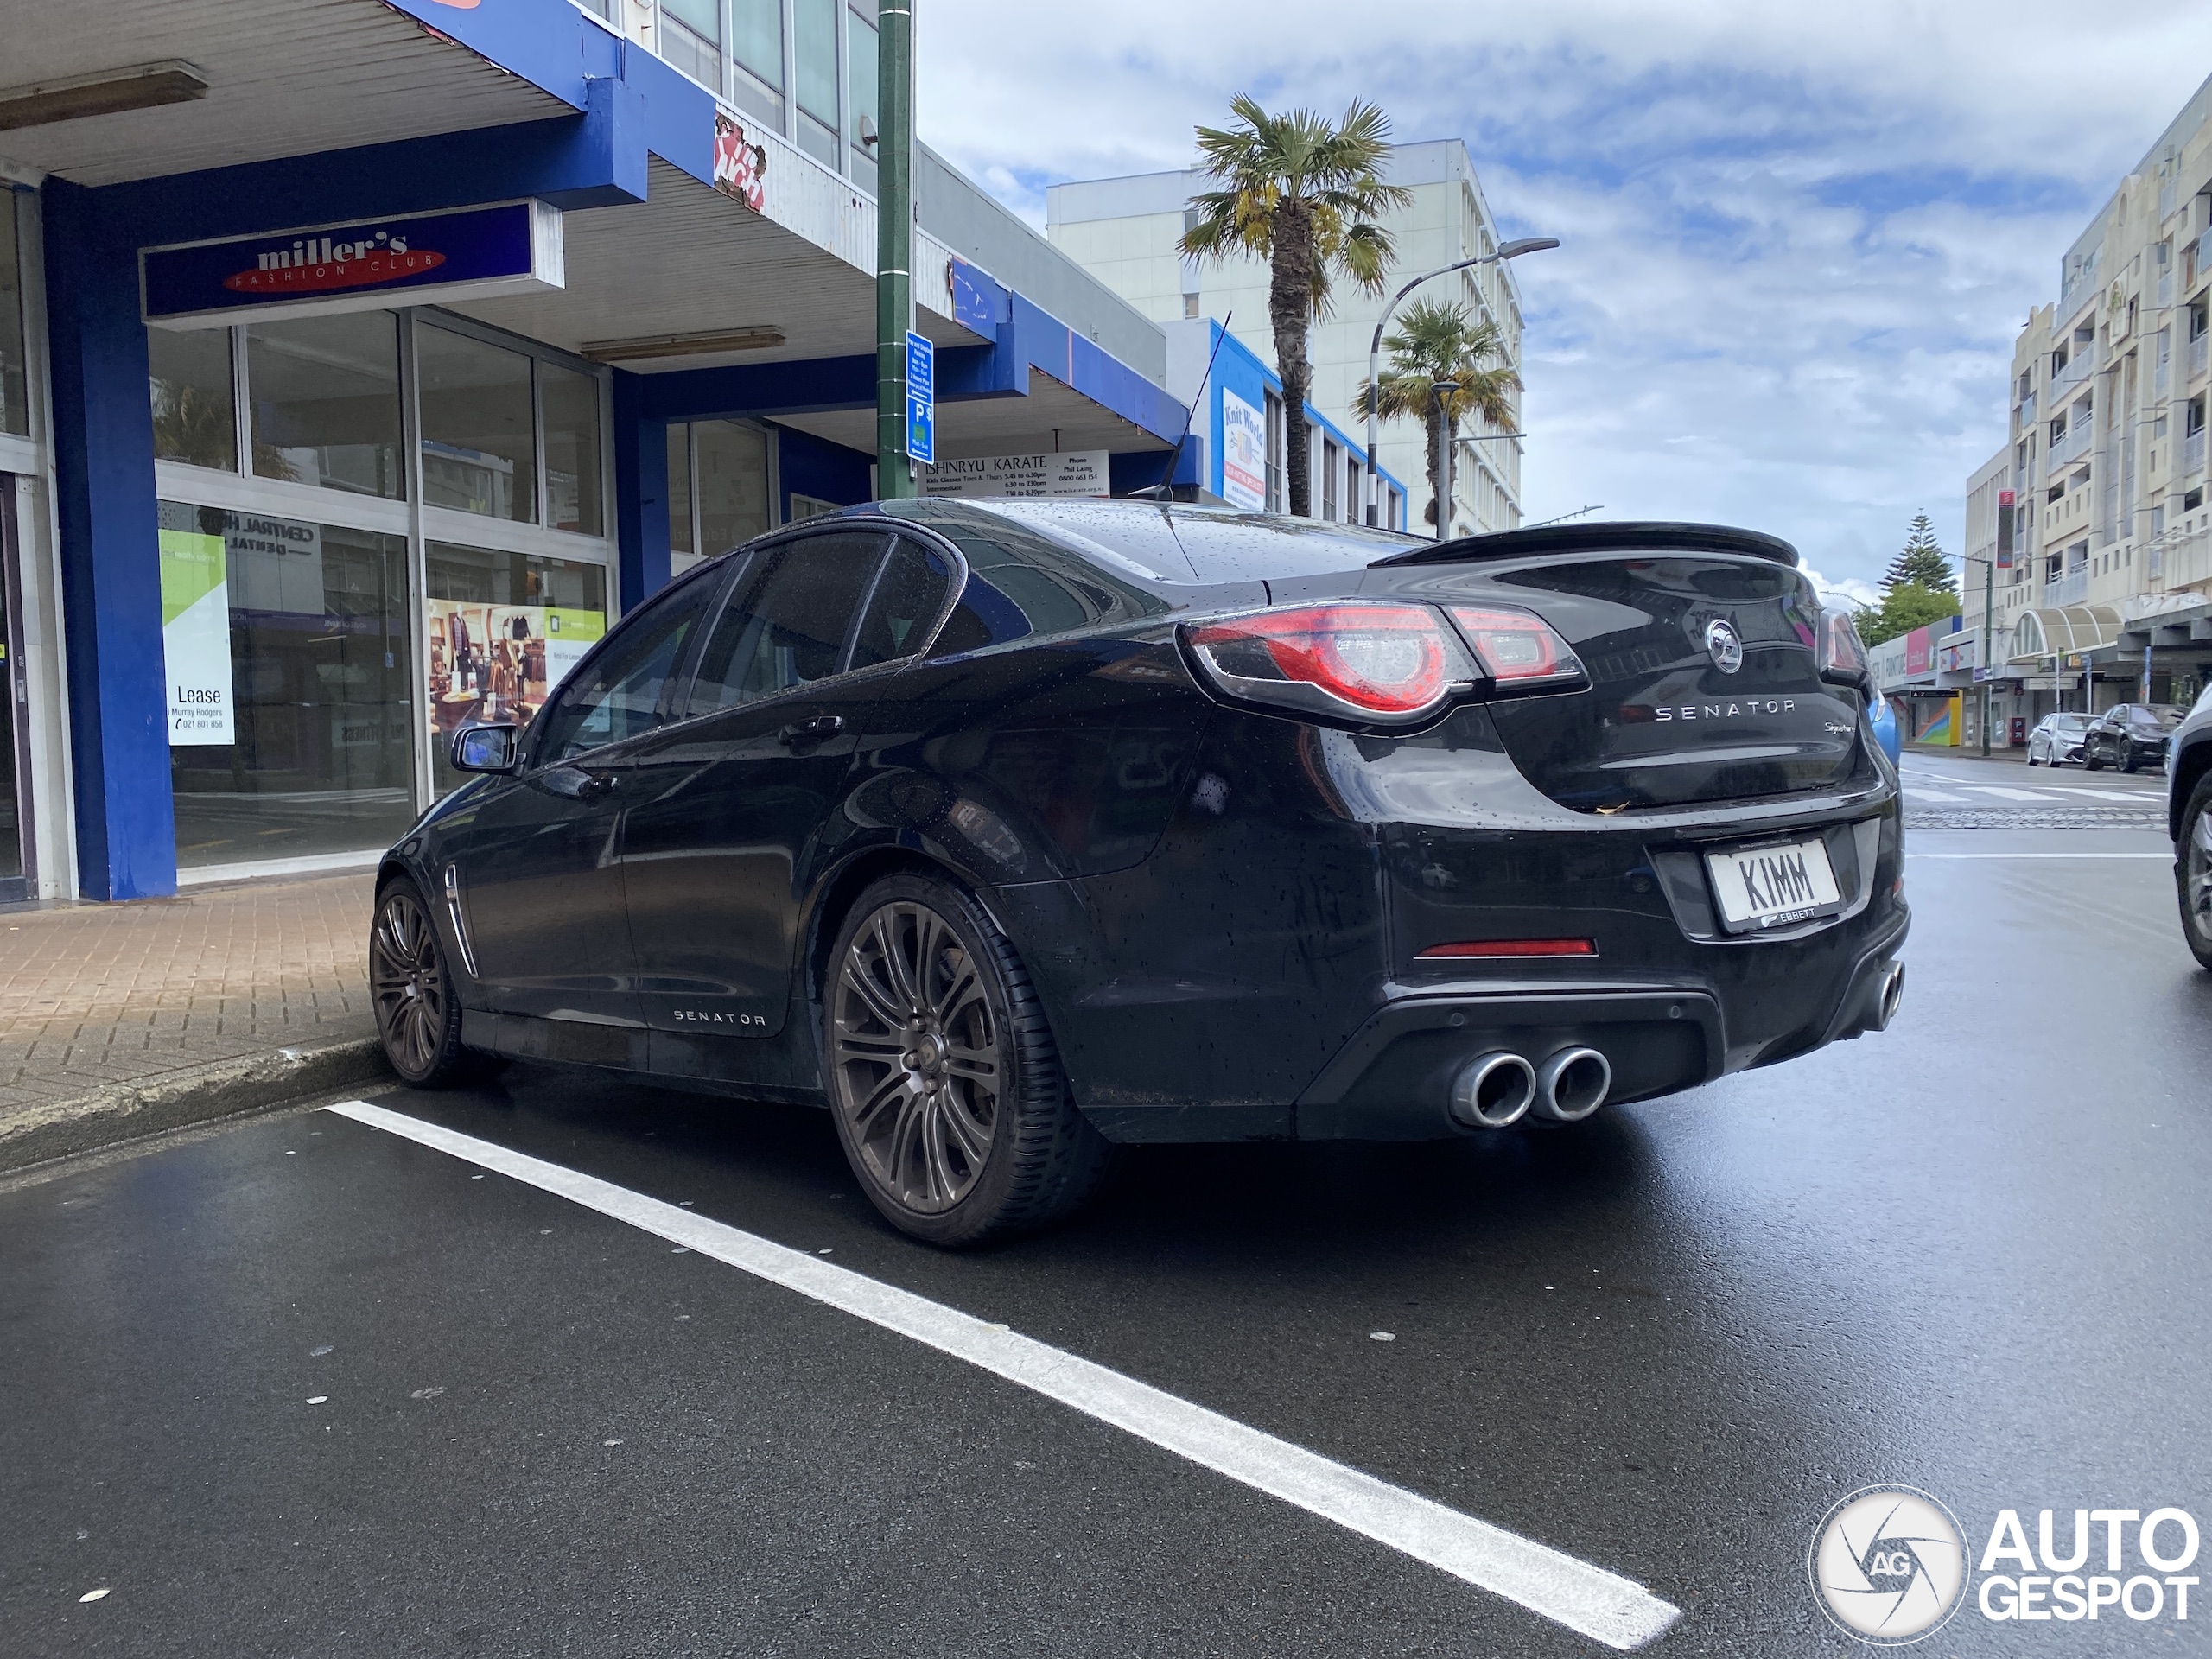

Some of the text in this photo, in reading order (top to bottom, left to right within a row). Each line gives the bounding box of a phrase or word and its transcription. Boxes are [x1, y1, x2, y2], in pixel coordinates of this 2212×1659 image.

[257, 231, 408, 271] miller's
[235, 255, 432, 287] FASHION CLUB
[916, 403, 924, 422] P
[1224, 405, 1263, 448] Knit World
[925, 455, 1047, 474] ISHINRYU KARATE
[178, 685, 221, 703] Lease
[171, 708, 194, 718] Murray
[196, 708, 223, 718] Rodgers
[1656, 699, 1796, 721] SENATOR
[183, 720, 195, 728] 021
[197, 720, 208, 728] 801
[1738, 852, 1815, 911] KIMM
[1780, 907, 1815, 922] EBBETT
[673, 1010, 766, 1026] SENATOR
